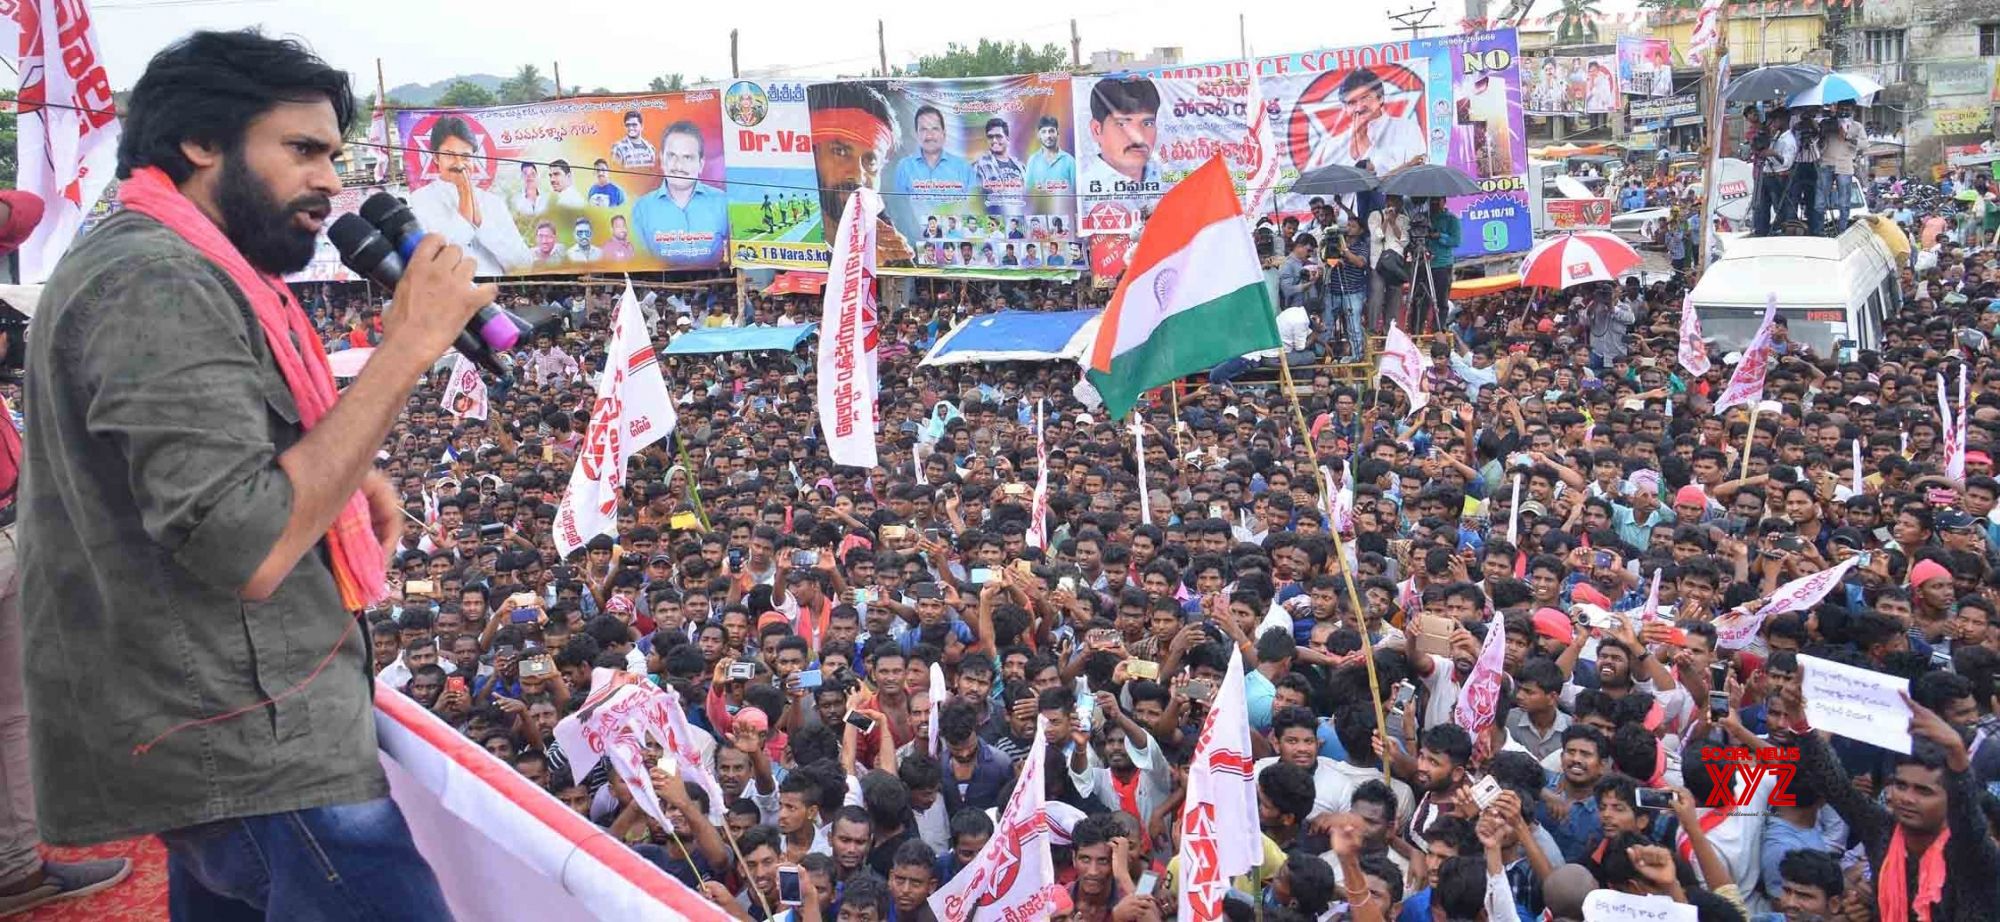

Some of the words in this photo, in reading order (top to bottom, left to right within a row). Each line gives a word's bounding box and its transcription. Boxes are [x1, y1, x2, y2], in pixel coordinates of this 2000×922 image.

[1462, 49, 1512, 75] NO
[1477, 177, 1525, 193] OOL
[1482, 220, 1509, 252] 9
[1806, 311, 1842, 322] PRESS
